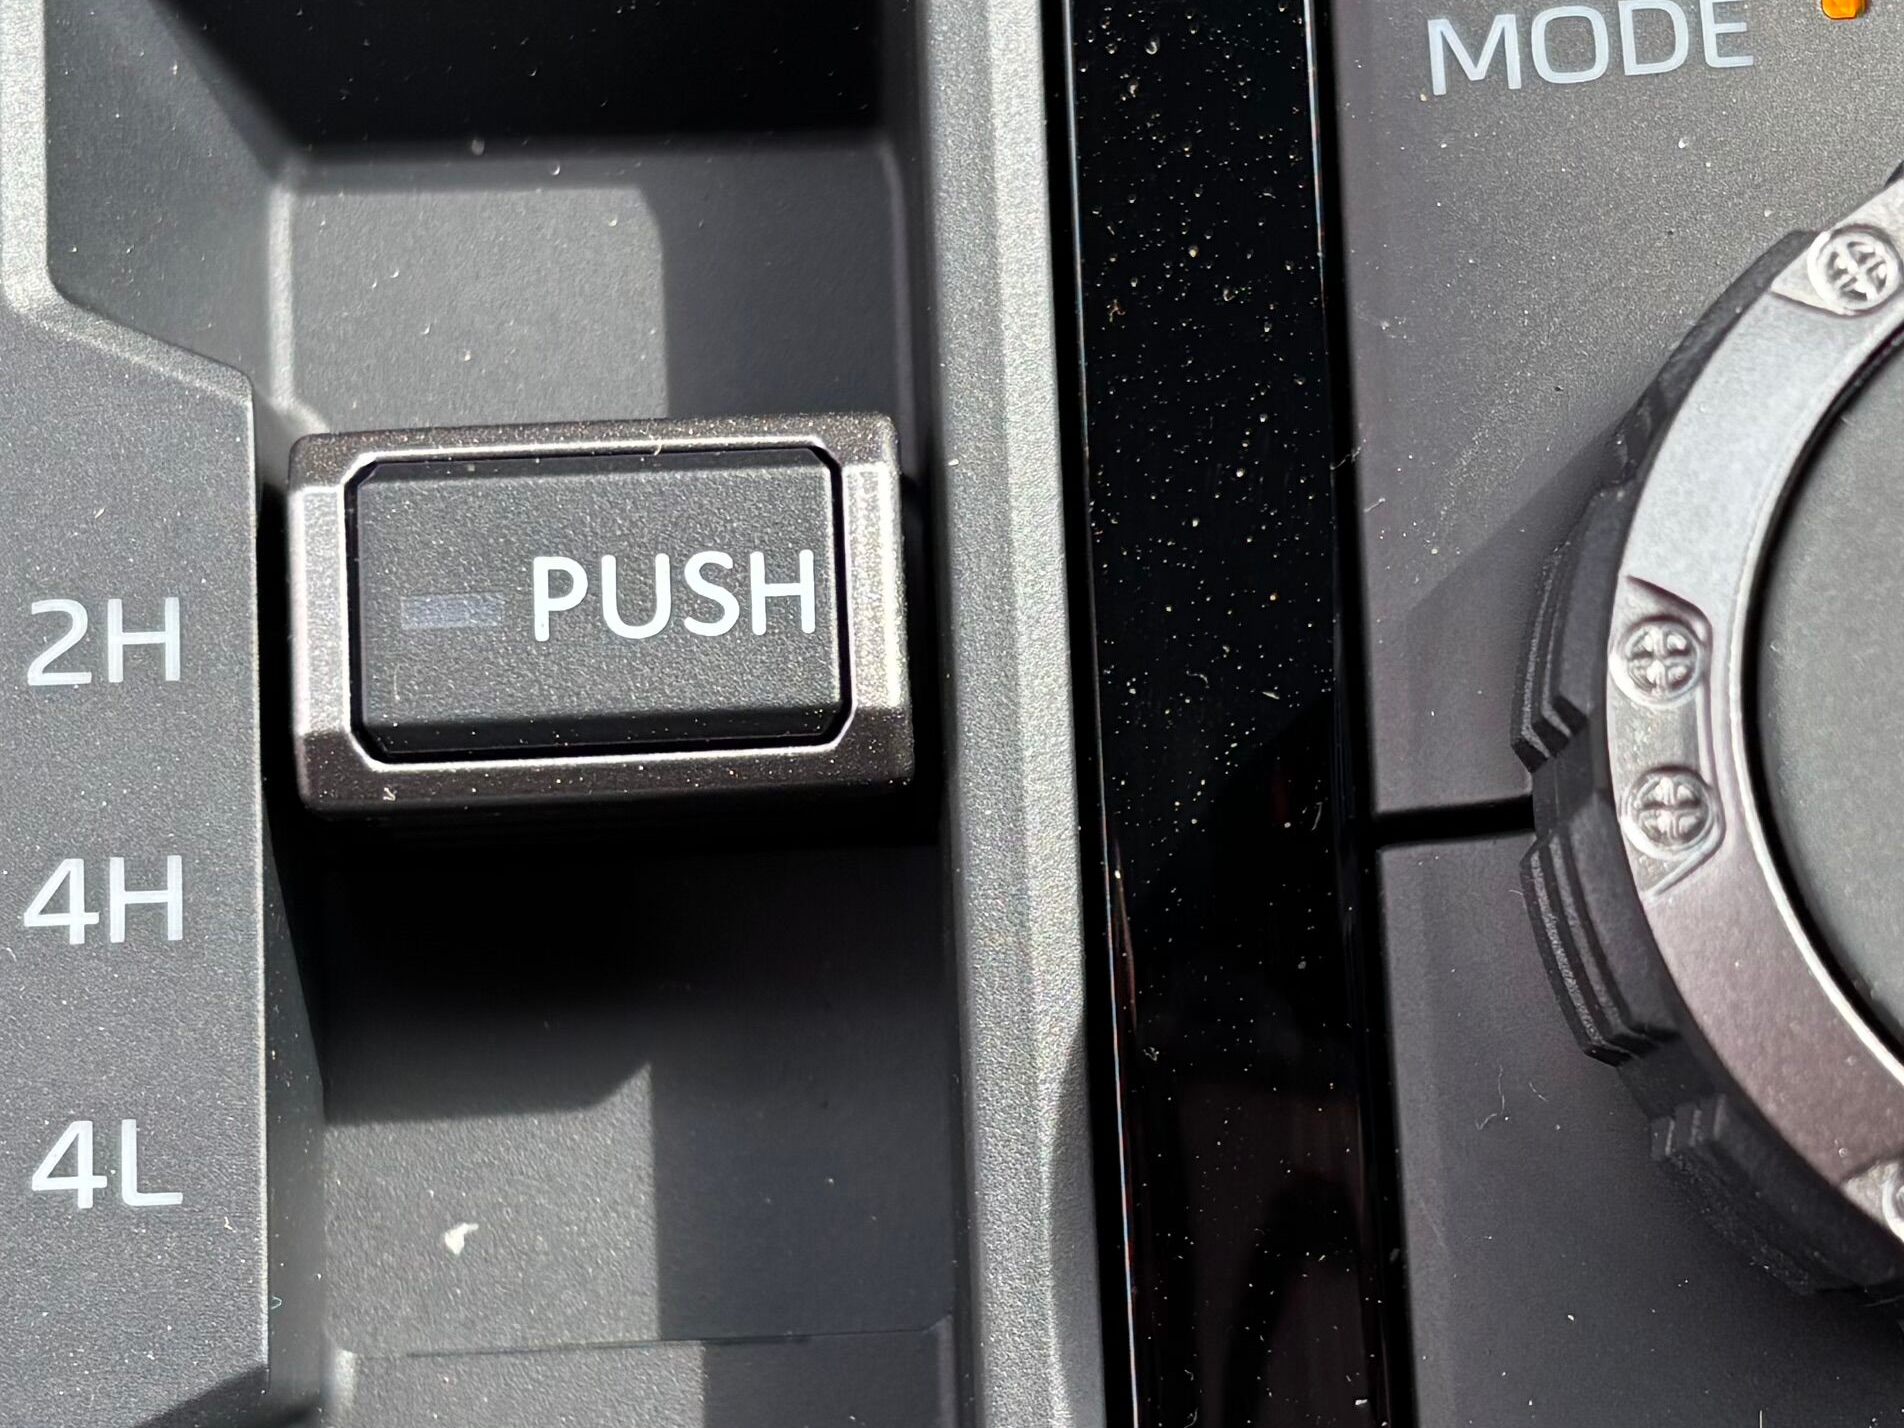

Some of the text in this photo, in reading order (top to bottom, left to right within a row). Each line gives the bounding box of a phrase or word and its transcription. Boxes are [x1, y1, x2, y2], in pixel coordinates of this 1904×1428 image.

[531, 549, 820, 642] PUSH
[25, 596, 182, 687] 2H
[23, 854, 186, 946] 4H
[29, 1120, 185, 1211] 4L
